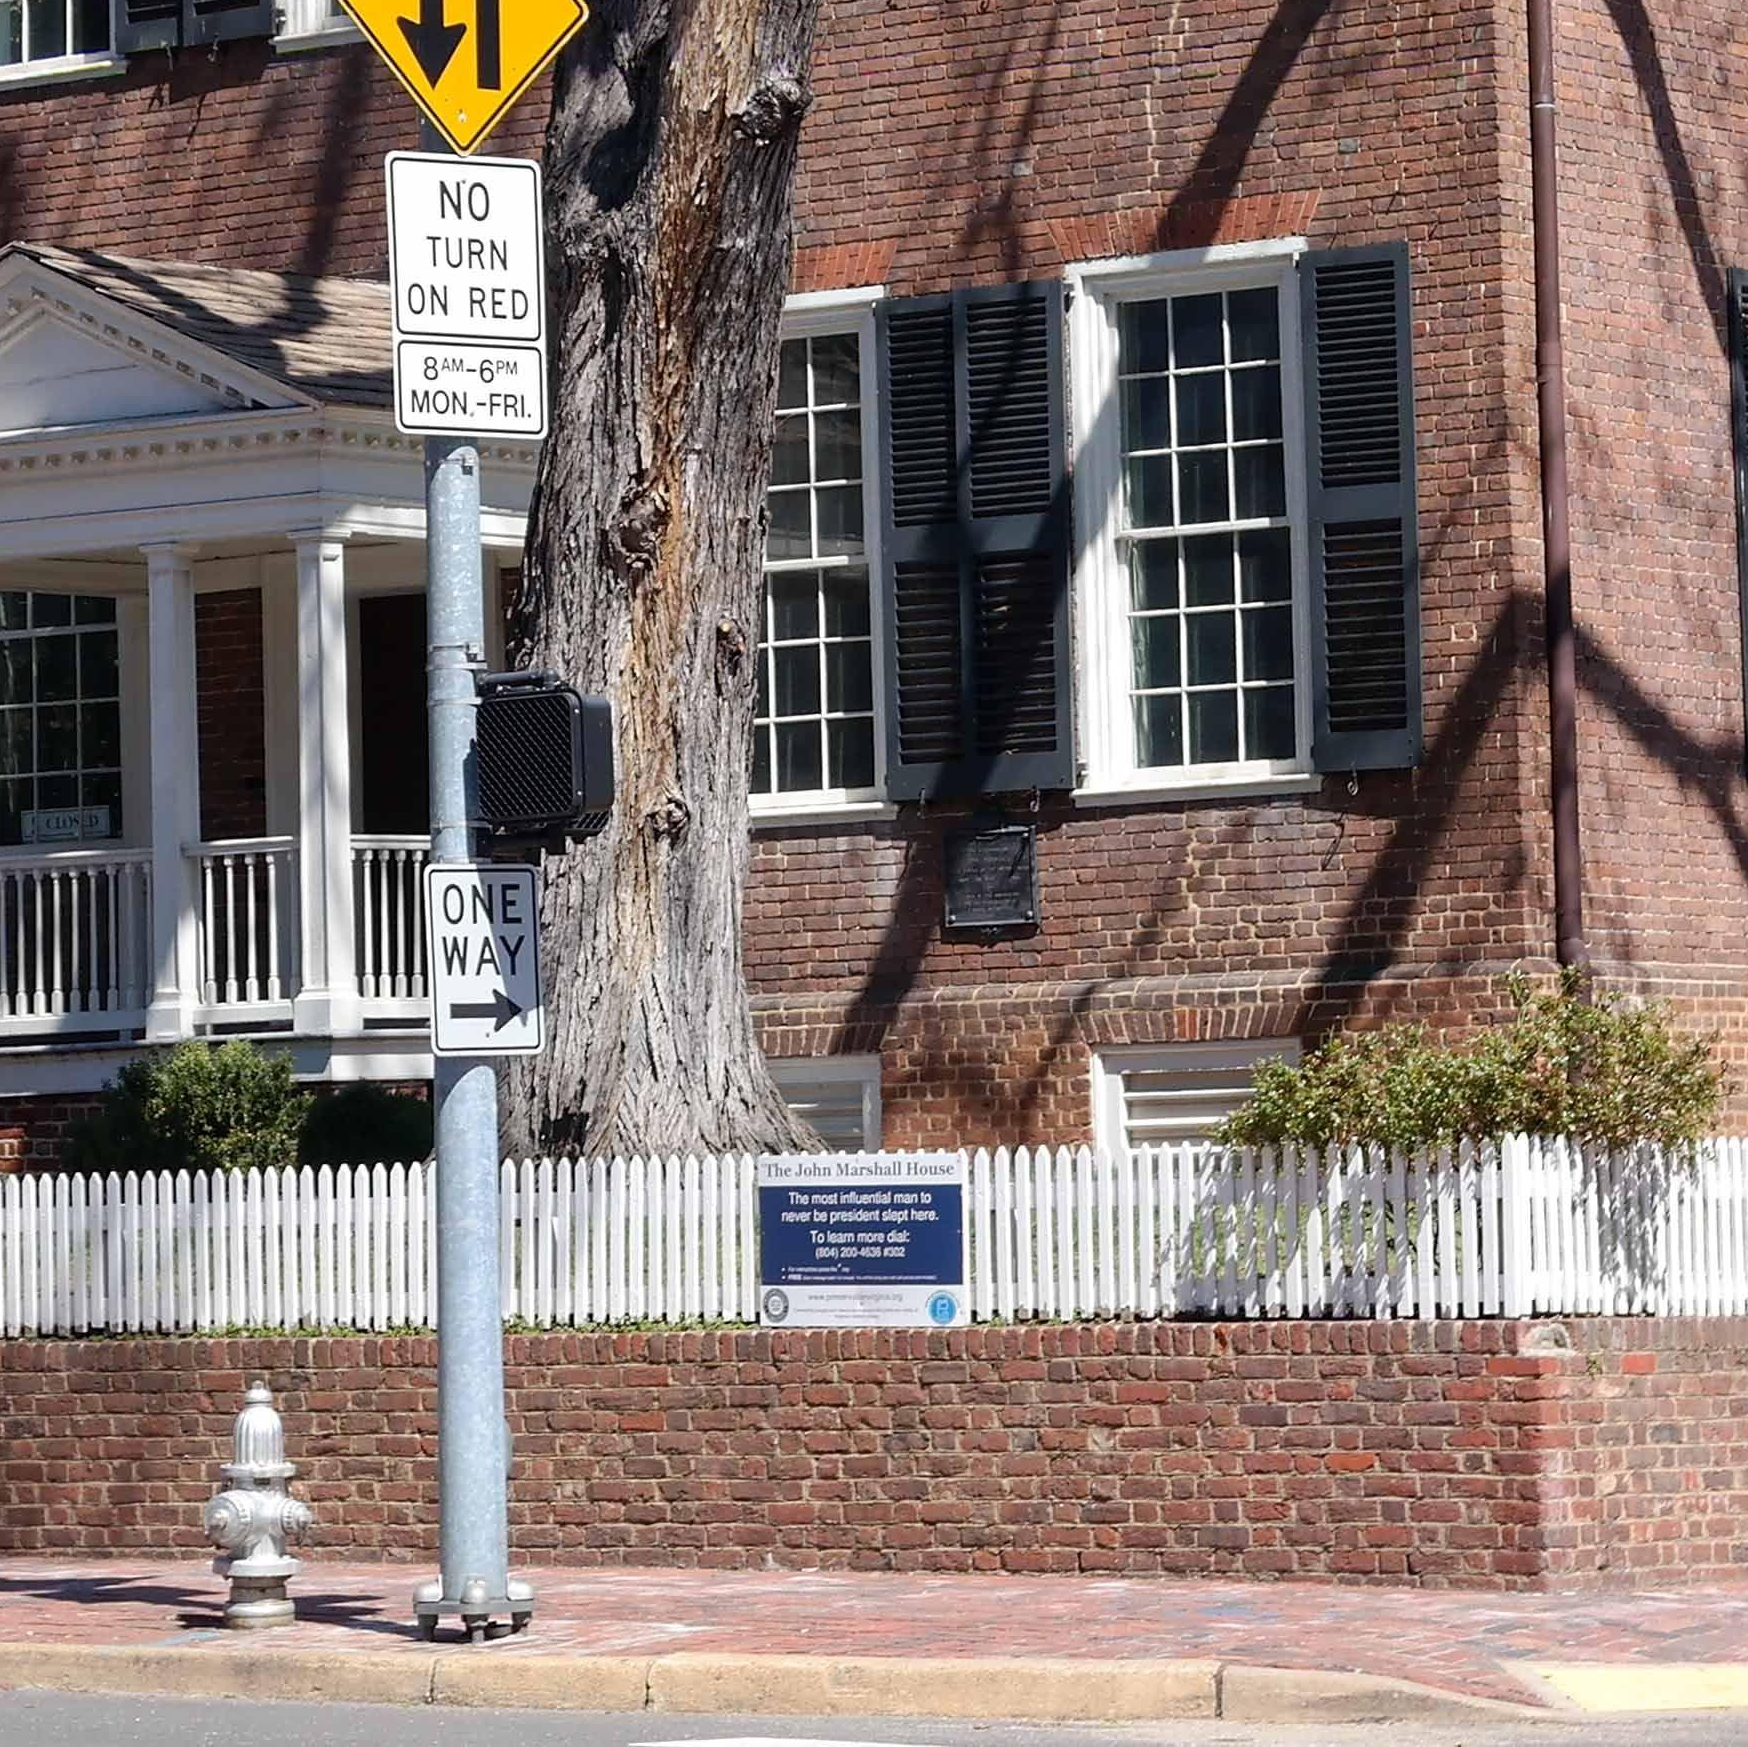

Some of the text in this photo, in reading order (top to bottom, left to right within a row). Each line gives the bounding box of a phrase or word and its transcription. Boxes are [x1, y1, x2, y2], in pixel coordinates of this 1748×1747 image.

[438, 180, 490, 222] NO
[426, 235, 508, 271] TURN
[407, 282, 529, 320] ON RED
[442, 883, 523, 925] ONE
[441, 934, 526, 977] WAY
[764, 1161, 955, 1178] The John Marshall House
[788, 1190, 932, 1205] The most influential man to
[781, 1207, 940, 1225] never be president slept here.
[809, 1229, 910, 1244] To learn more dial:
